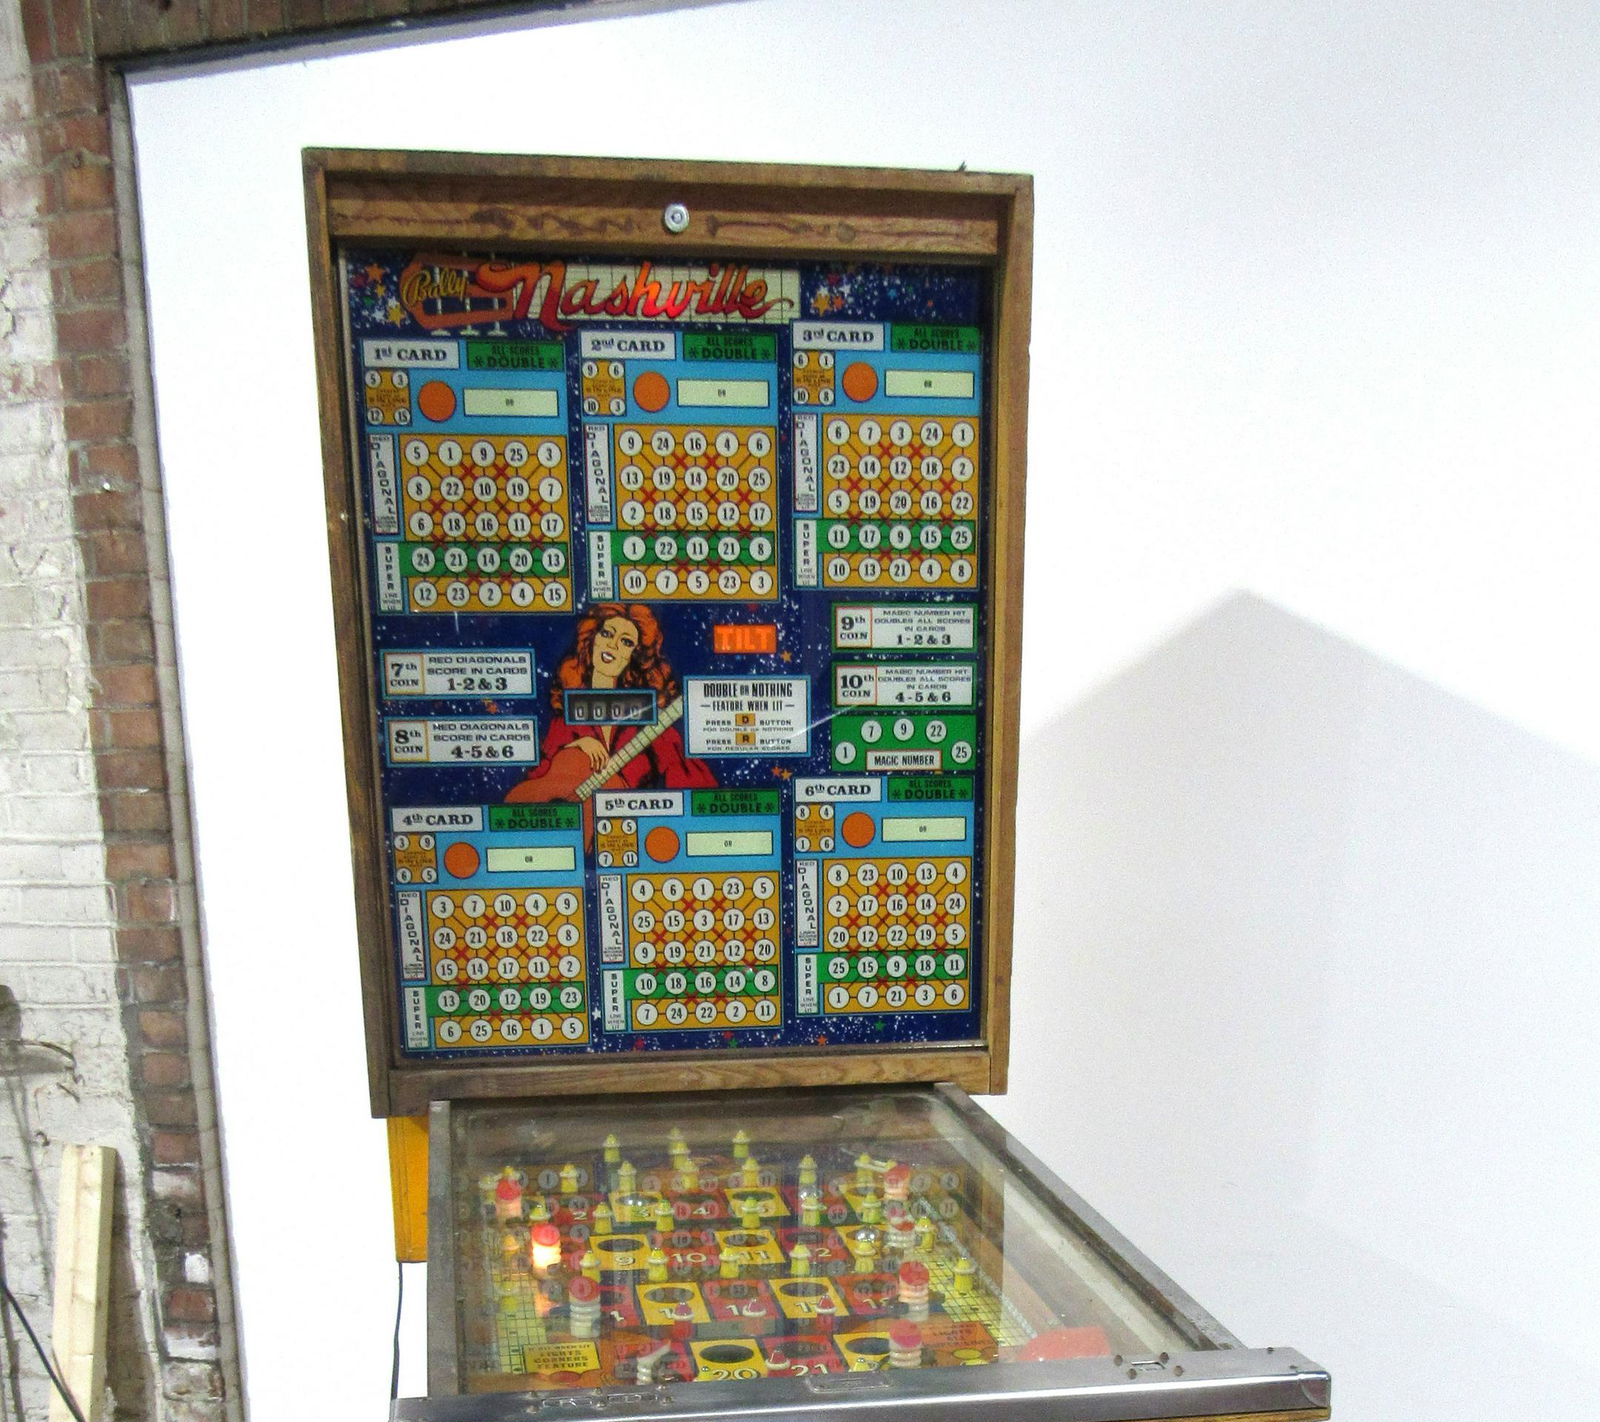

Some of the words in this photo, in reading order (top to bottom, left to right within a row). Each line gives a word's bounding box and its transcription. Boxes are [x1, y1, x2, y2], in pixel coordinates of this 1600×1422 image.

[402, 266, 468, 305] Bally
[475, 259, 795, 332] Nashville
[803, 329, 825, 343] 3rd
[827, 331, 874, 343] CARD
[591, 338, 615, 351] 2nd
[617, 340, 665, 352] CARD
[909, 339, 964, 351] DOUBLE
[397, 349, 447, 362] CARD
[701, 347, 757, 360] DOUBLE
[487, 357, 545, 369] DOUBLE
[841, 616, 866, 631] 9th
[716, 628, 770, 650] TILT
[840, 632, 868, 640] COIN
[428, 656, 453, 664] RED
[456, 656, 527, 664] DIAGONALS
[391, 663, 418, 678] 7th
[426, 667, 466, 675] SCORE
[471, 667, 483, 675] IN
[486, 667, 528, 675] CARDS
[390, 678, 419, 687] COIN
[495, 677, 508, 691] 3
[840, 674, 875, 689] 10th
[703, 682, 738, 698] DOUBLE
[740, 685, 750, 697] OR
[751, 682, 793, 698] NOTHING
[842, 690, 871, 698] COIN
[712, 700, 743, 712] FEATURE
[747, 700, 769, 712] WHEN
[772, 700, 783, 711] LIT
[459, 723, 530, 731] DIAGONALS
[394, 729, 422, 745] 8th
[433, 734, 473, 742] SCORE
[475, 734, 487, 742] IN
[489, 734, 531, 742] CARDS
[394, 745, 423, 754] COIN
[502, 745, 515, 759] 6
[874, 755, 899, 766] MAGIC
[901, 754, 935, 766] NUMBER
[805, 784, 826, 797] 6th
[827, 784, 871, 796] CARD
[904, 788, 956, 799] DOUBLE
[605, 799, 626, 812] 5th
[630, 799, 674, 811] CARD
[709, 802, 763, 814] DOUBLE
[402, 812, 424, 827] 4th
[426, 812, 474, 826] CARD
[507, 817, 564, 830] DOUBLE
[672, 1252, 707, 1264] 10
[537, 1362, 588, 1370] FEATURE
